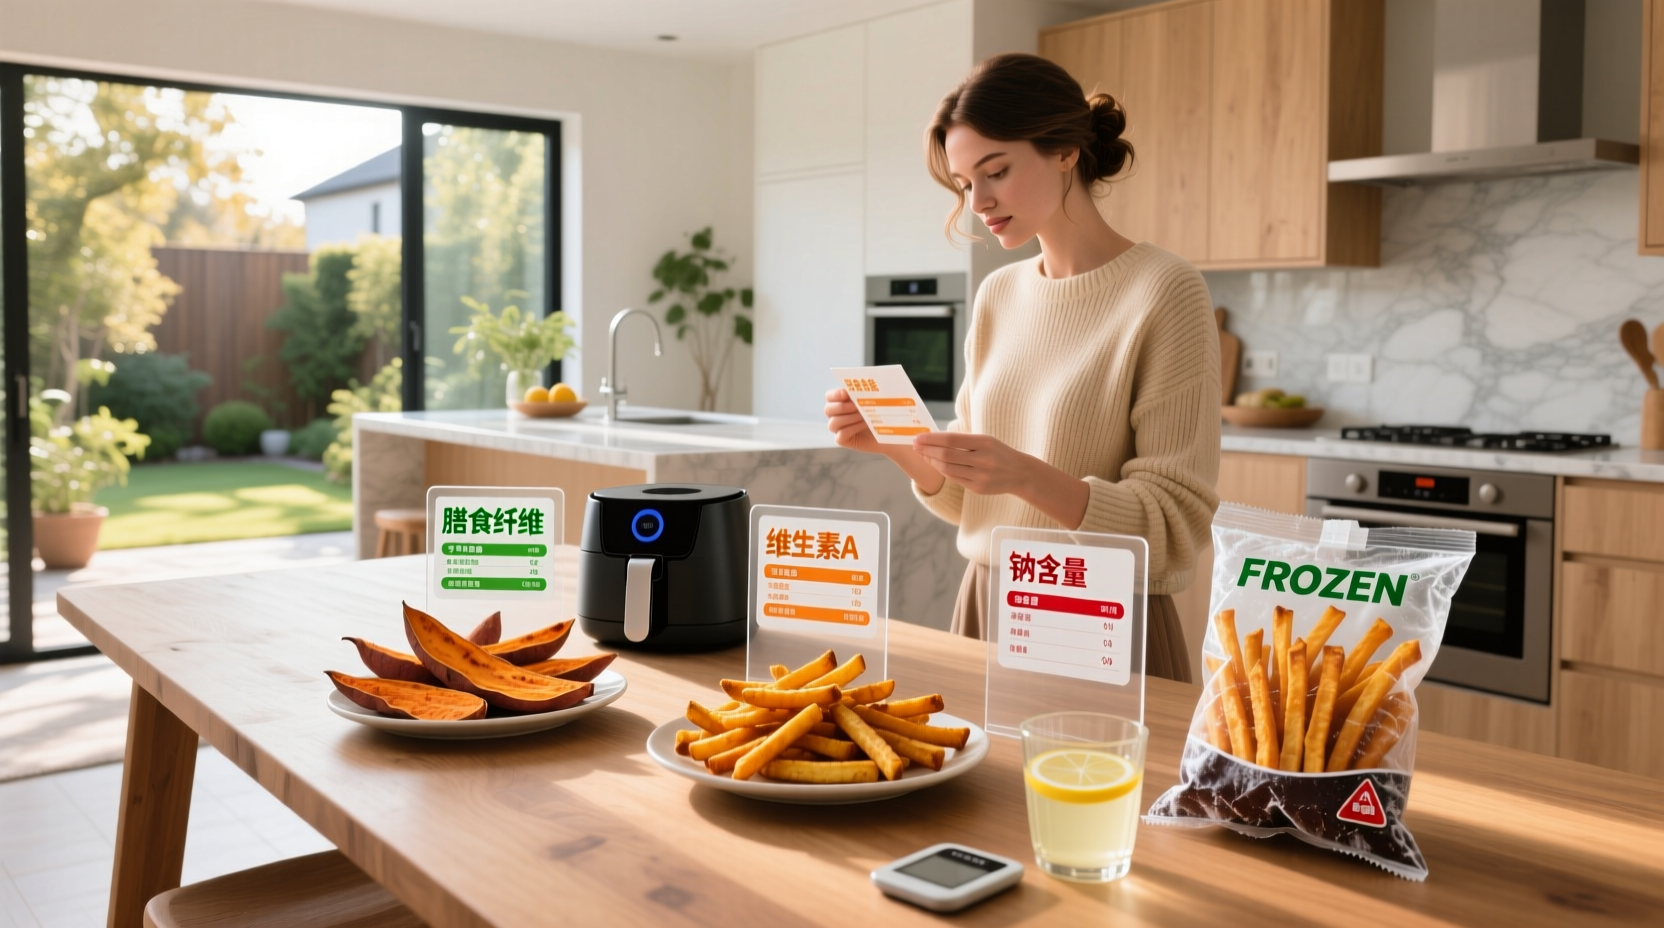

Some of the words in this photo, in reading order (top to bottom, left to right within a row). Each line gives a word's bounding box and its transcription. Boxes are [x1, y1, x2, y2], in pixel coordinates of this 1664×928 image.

[442, 506, 544, 536] 膳食纤维
[765, 527, 859, 560] 维生素A
[1009, 550, 1088, 588] 钠含量
[1237, 557, 1408, 606] FROZEN
